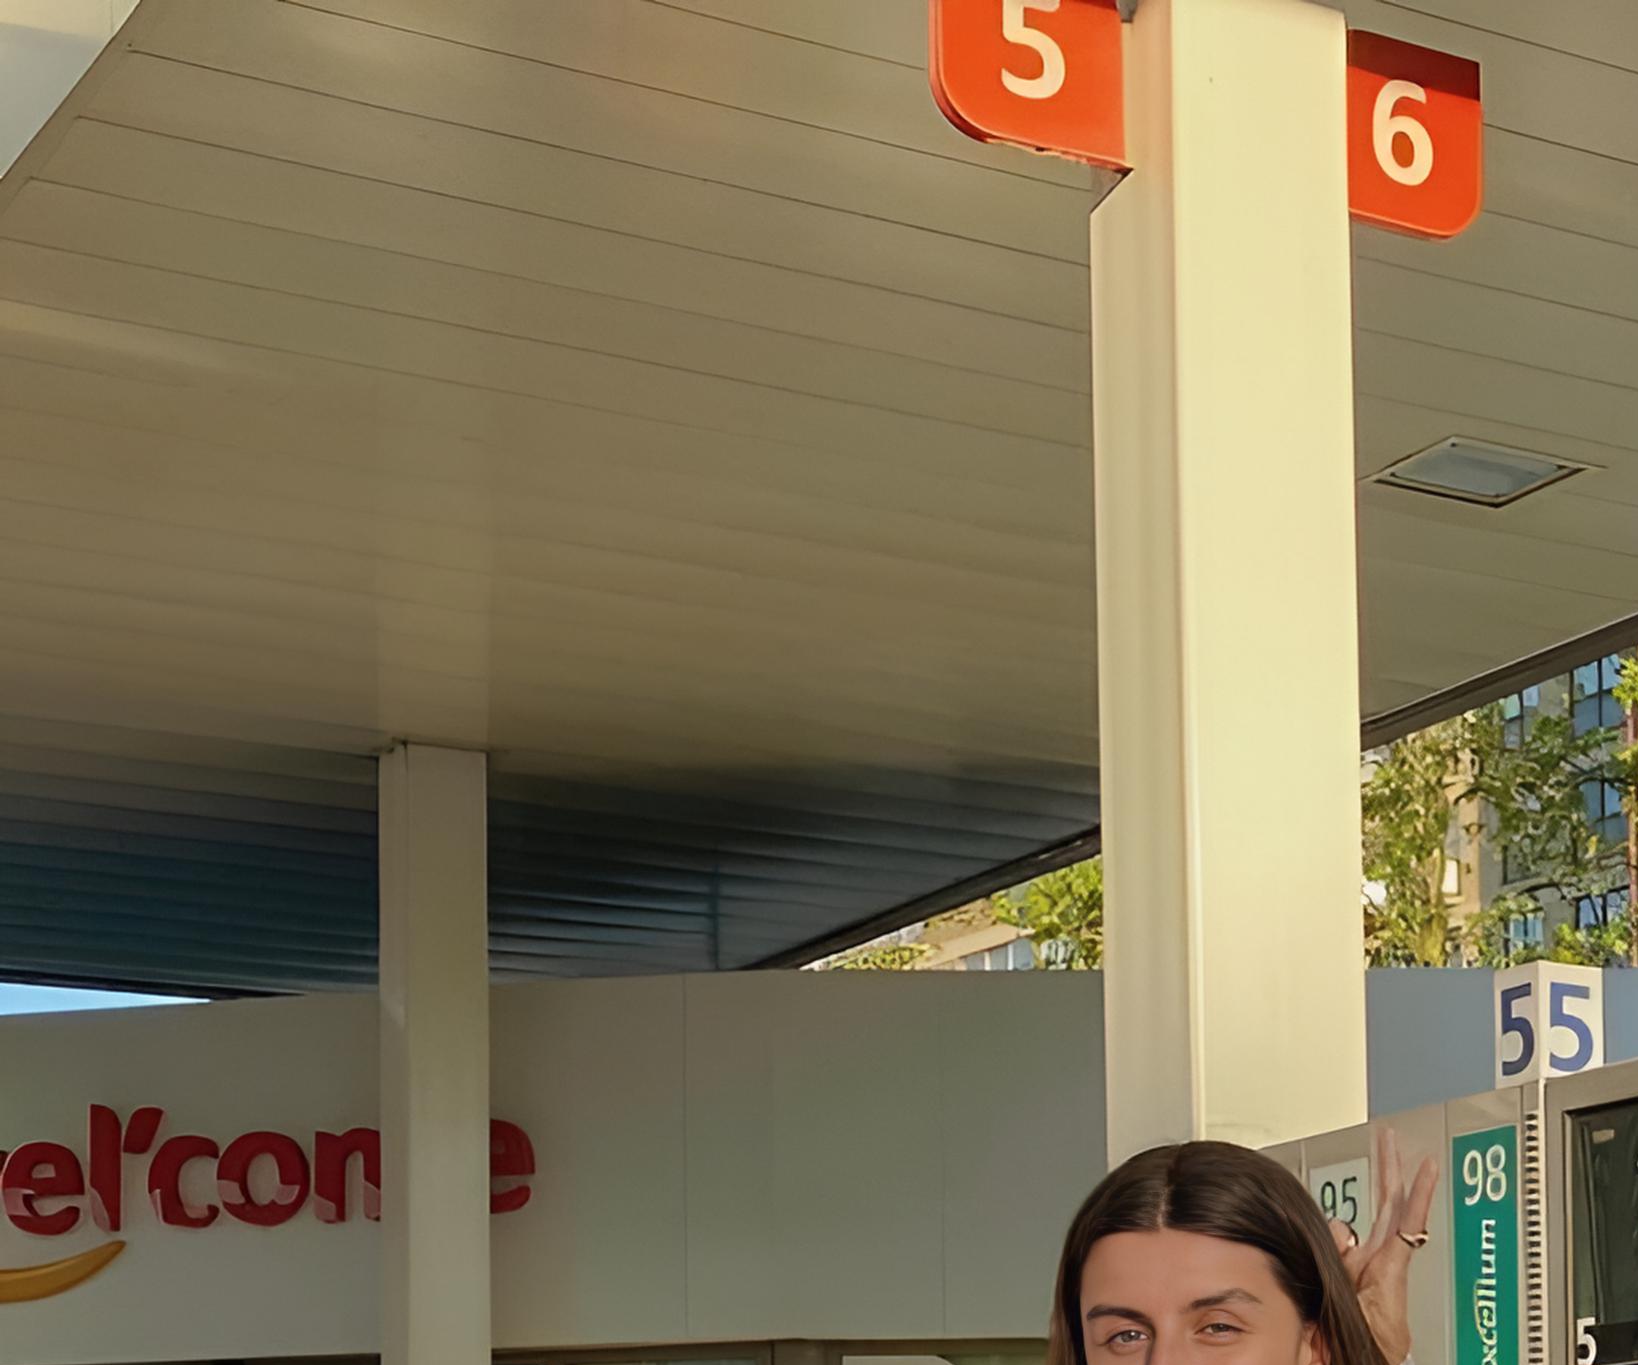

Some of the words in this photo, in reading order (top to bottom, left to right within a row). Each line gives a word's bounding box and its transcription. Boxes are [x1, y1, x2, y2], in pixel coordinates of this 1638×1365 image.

[1001, 0, 1065, 99] 5
[1372, 79, 1433, 186] 6
[1321, 1176, 1357, 1225] 95
[1462, 1145, 1507, 1206] 98
